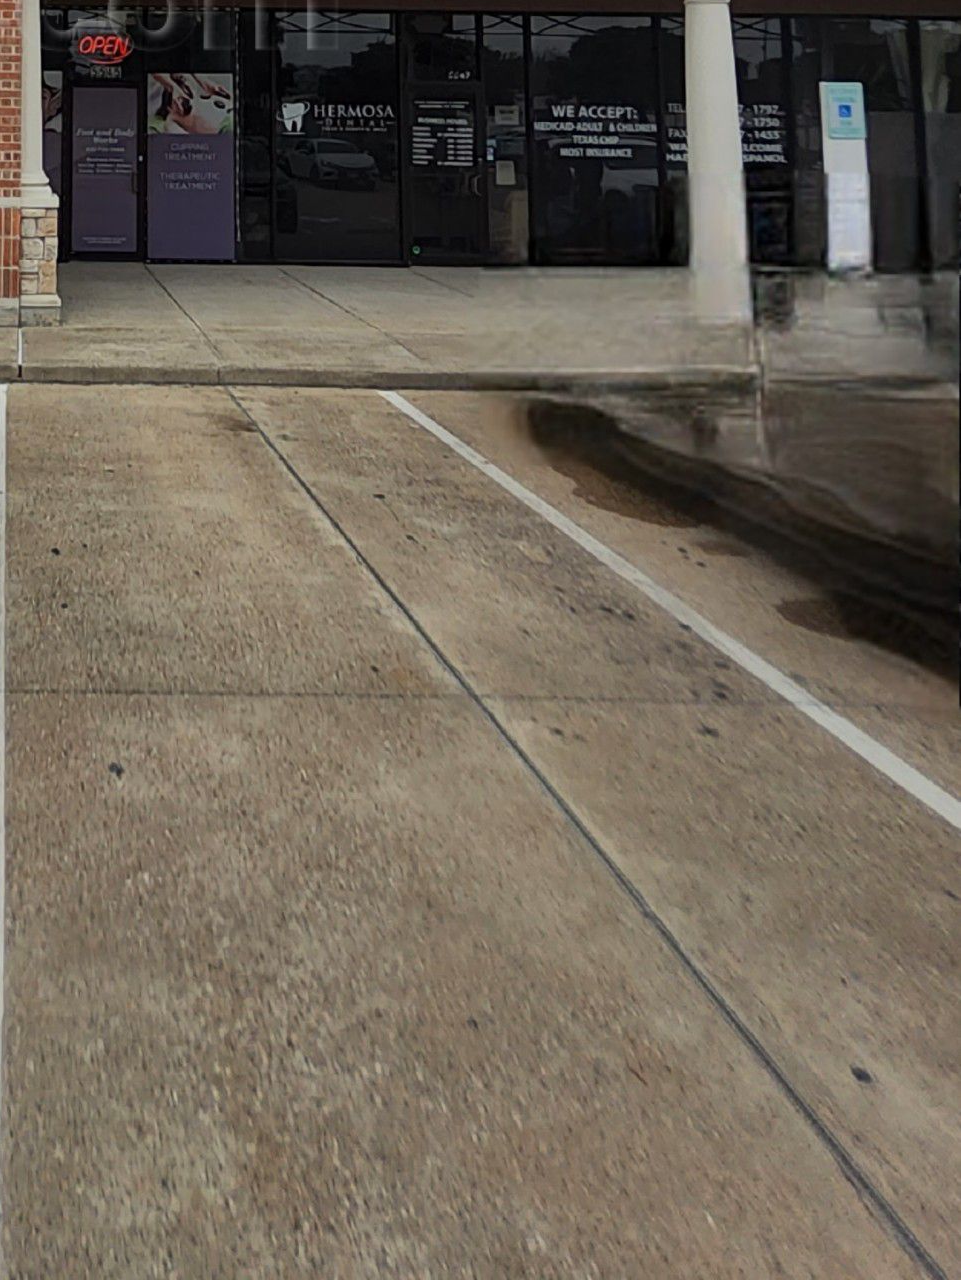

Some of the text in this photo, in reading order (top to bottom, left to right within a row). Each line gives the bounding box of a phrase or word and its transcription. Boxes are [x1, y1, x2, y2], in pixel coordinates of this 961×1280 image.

[79, 35, 130, 56] OPEN
[314, 104, 395, 118] HERMOSA
[551, 105, 638, 120] WE ACCEPT:
[617, 123, 658, 133] CHILDREN
[165, 152, 216, 161] TREATMENT
[559, 148, 633, 158] MOST INSURANCE
[165, 182, 216, 190] TREATMENT
